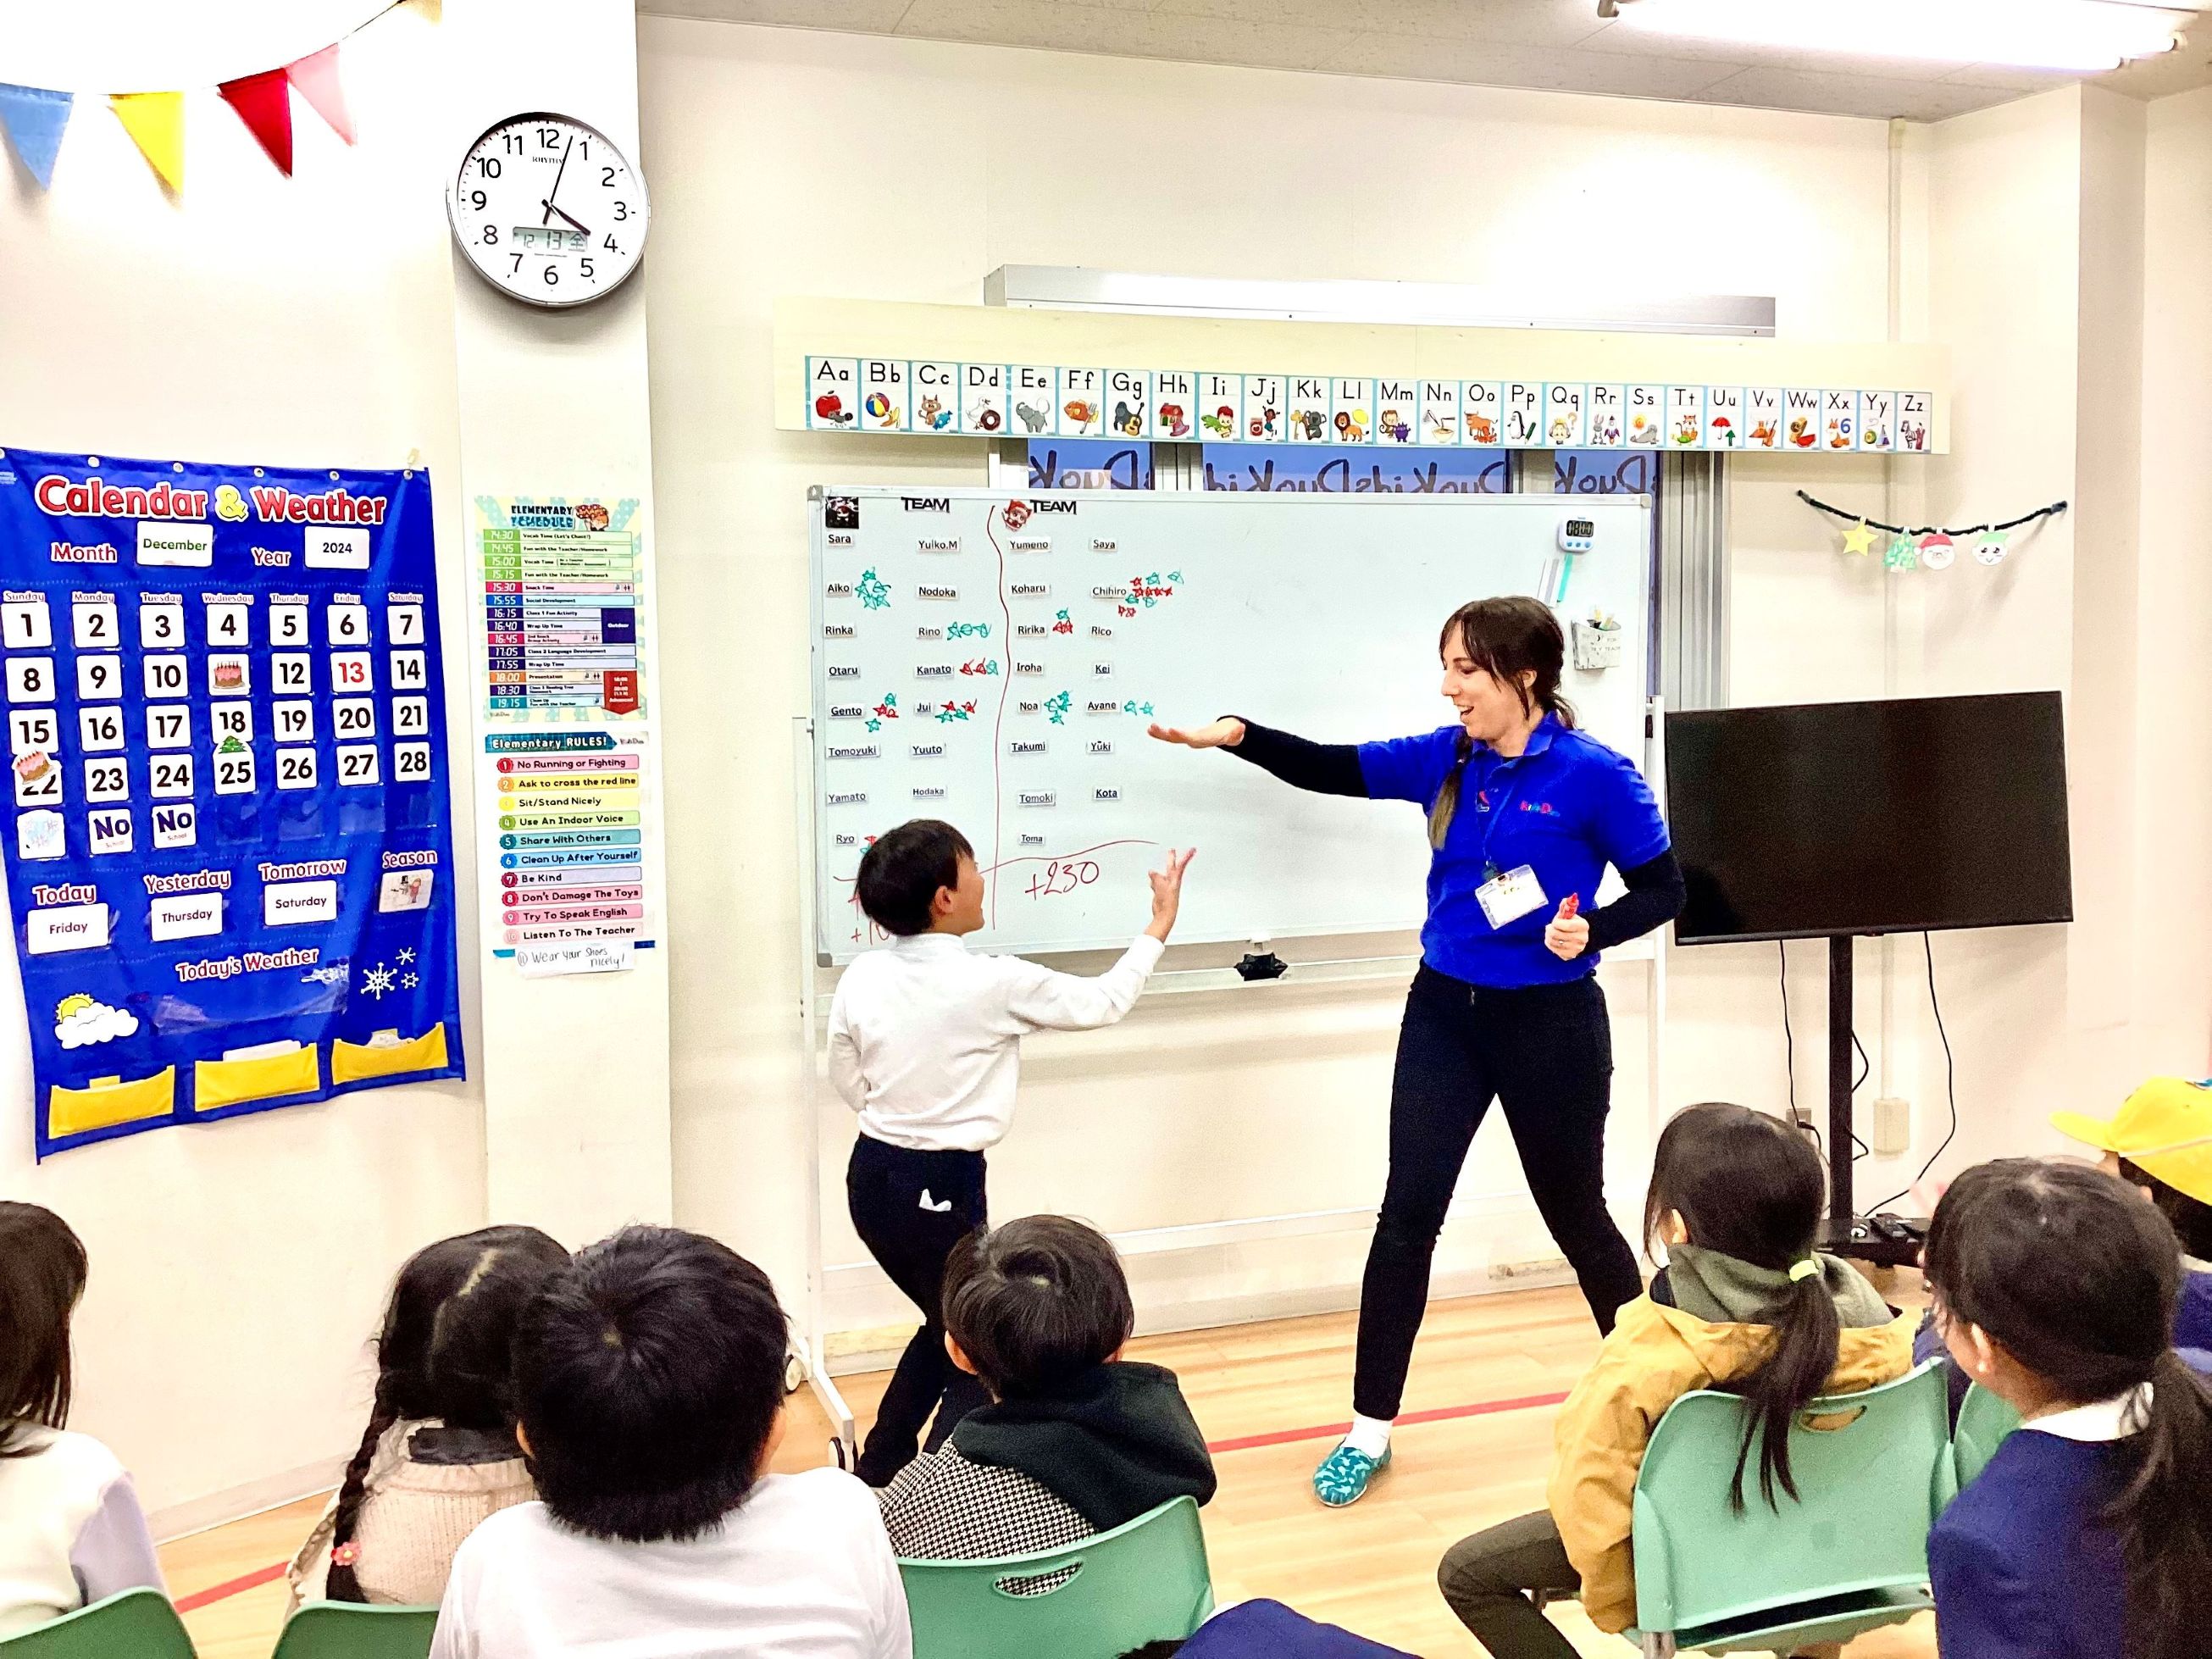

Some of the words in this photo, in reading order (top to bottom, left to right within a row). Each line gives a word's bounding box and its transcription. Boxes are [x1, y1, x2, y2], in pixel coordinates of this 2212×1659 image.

[536, 129, 559, 149] 12
[502, 135, 523, 155] 11
[477, 158, 502, 178] 10
[547, 232, 561, 249] 13
[818, 361, 849, 381] Aa
[870, 363, 901, 383] Bb
[919, 364, 949, 386] Cc
[969, 366, 999, 387] Dd
[1021, 369, 1047, 388] Ee
[1068, 369, 1095, 390] Ff
[1112, 373, 1142, 400] Gg
[1160, 375, 1187, 394] Hh
[1211, 376, 1226, 396] Ii
[1252, 378, 1276, 405] Jj
[1297, 380, 1322, 399] Kk
[1343, 380, 1361, 400] Ll
[1381, 382, 1414, 401] Mm
[1427, 383, 1452, 402] Nn
[1469, 384, 1495, 402] Oo
[1511, 385, 1535, 410] Pp
[1551, 386, 1579, 412] Qq
[1594, 387, 1616, 405] Rr
[1633, 388, 1655, 406] Ss
[1674, 388, 1695, 407] Tt
[1713, 389, 1737, 407] Uu
[1752, 390, 1775, 407] Vv
[1788, 391, 1818, 409] Ww
[1827, 392, 1849, 410] Xx
[1866, 395, 1888, 419] Yy
[1904, 395, 1924, 412] Zz
[39, 479, 206, 518] Calendar
[217, 485, 246, 519] &
[254, 490, 386, 523] Weather
[901, 497, 950, 513] TEAM
[511, 505, 573, 514] ELEMENTARY
[1030, 500, 1077, 515] TEAM
[143, 537, 207, 552] December
[829, 535, 851, 543] Sara
[323, 542, 352, 554] 2024
[919, 541, 957, 549] Yuiko.M
[1010, 541, 1049, 549] Yumeno
[1093, 540, 1116, 550] Saya
[53, 546, 116, 562] Month
[254, 548, 290, 565] Year
[828, 584, 850, 592] Aiko
[919, 586, 956, 597] Nodoka
[1012, 585, 1045, 593] Koharu
[1093, 586, 1127, 596] Chihiro
[6, 593, 44, 602] Sunday
[75, 594, 114, 603] Monday
[143, 594, 181, 605] Tuesday
[204, 595, 253, 604] Wednesday
[271, 595, 308, 604] Thursday
[335, 595, 360, 603] Friday
[390, 594, 423, 602] Saturday
[20, 613, 32, 637] 1
[88, 614, 106, 637] 2
[155, 615, 170, 637] 3
[220, 614, 236, 636] 4
[282, 615, 297, 636] 5
[340, 614, 355, 635] 6
[399, 614, 413, 635] 7
[825, 625, 853, 635] Rinka
[1018, 625, 1045, 635] Ririka
[1091, 626, 1112, 635] Rico
[918, 627, 940, 635] Rino
[829, 666, 858, 676] Otaru
[917, 666, 952, 675] Kanato
[1017, 663, 1042, 672] Iroha
[1095, 664, 1111, 674] Kei
[831, 707, 862, 716] Gento
[917, 703, 931, 712] Jui
[1019, 702, 1038, 711] Noa
[1088, 702, 1117, 712] Ayane
[492, 738, 561, 749] Elementary
[566, 736, 607, 746] RULES!
[1012, 742, 1045, 752] Takumi
[829, 746, 877, 757] Tomoyuki
[912, 746, 943, 755] Yuuto
[534, 760, 574, 769] Running
[589, 758, 626, 768] Fighting
[912, 788, 945, 796] Hodaka
[1095, 789, 1118, 798] Kota
[519, 798, 568, 807] Sit/Stand
[572, 796, 602, 806] Nicely
[829, 793, 866, 803] Yamato
[1019, 794, 1053, 804] Tomoki
[156, 810, 192, 833] No
[93, 816, 130, 840] No
[520, 836, 550, 845] Share
[552, 835, 574, 844] With
[836, 835, 854, 844] Ryo
[1021, 835, 1043, 844] Toma
[383, 851, 436, 868] Season
[521, 856, 549, 864] Clean
[552, 855, 564, 864] Up
[567, 853, 594, 862] After
[596, 852, 638, 861] Yourself
[261, 861, 345, 879] Tomorrow
[146, 872, 230, 892] Yesterday
[1025, 862, 1099, 901] +230
[36, 886, 96, 904] Today
[523, 891, 549, 902] Don't
[552, 891, 591, 901] Damage
[594, 890, 612, 898] The
[614, 889, 639, 898] Toys
[275, 896, 327, 908] Saturday
[162, 910, 213, 923] Thursday
[524, 913, 541, 922] Try
[560, 910, 590, 919] Speak
[593, 908, 628, 918] English
[49, 922, 88, 935] Friday
[524, 931, 556, 940] Listen
[596, 927, 635, 935] Teacher
[178, 959, 241, 980] Today's
[246, 949, 319, 971] Weather
